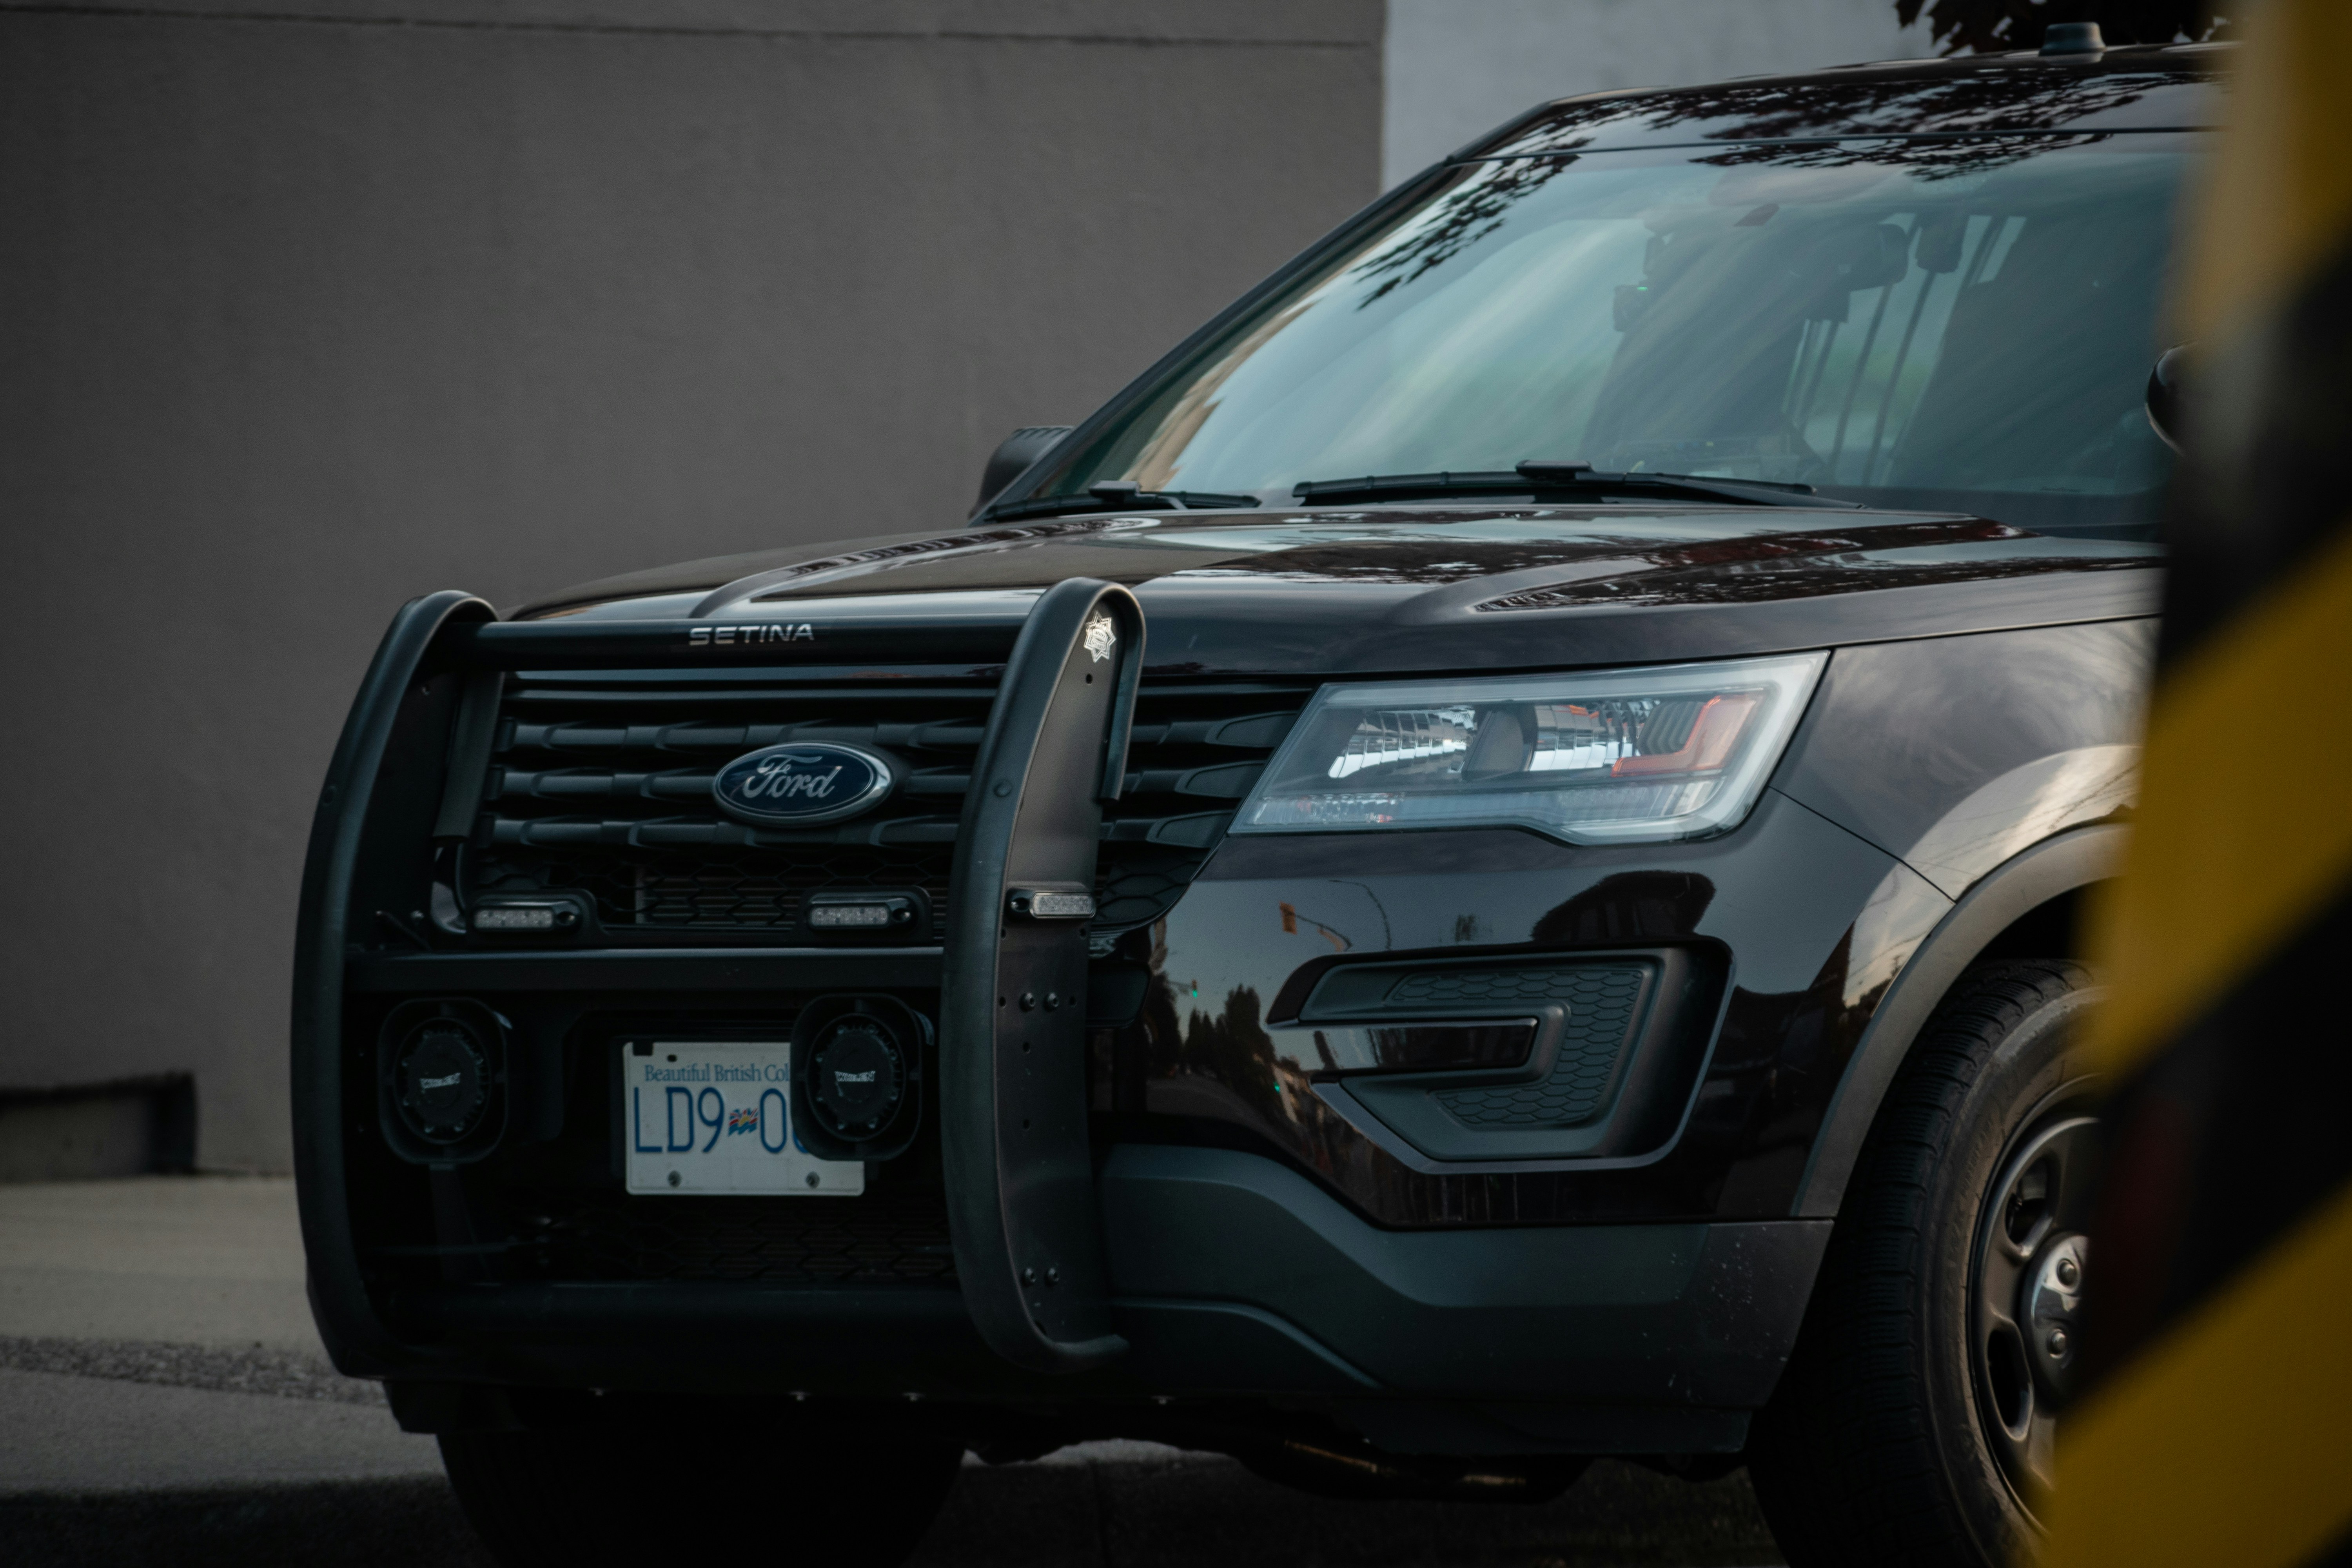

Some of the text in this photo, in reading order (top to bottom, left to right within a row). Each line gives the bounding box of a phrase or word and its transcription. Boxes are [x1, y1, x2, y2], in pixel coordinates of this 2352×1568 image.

[689, 623, 815, 646] SETINA
[742, 753, 842, 798] Ford
[644, 1063, 710, 1082] Beautiful
[714, 1063, 762, 1082] British
[633, 1087, 725, 1153] LD9
